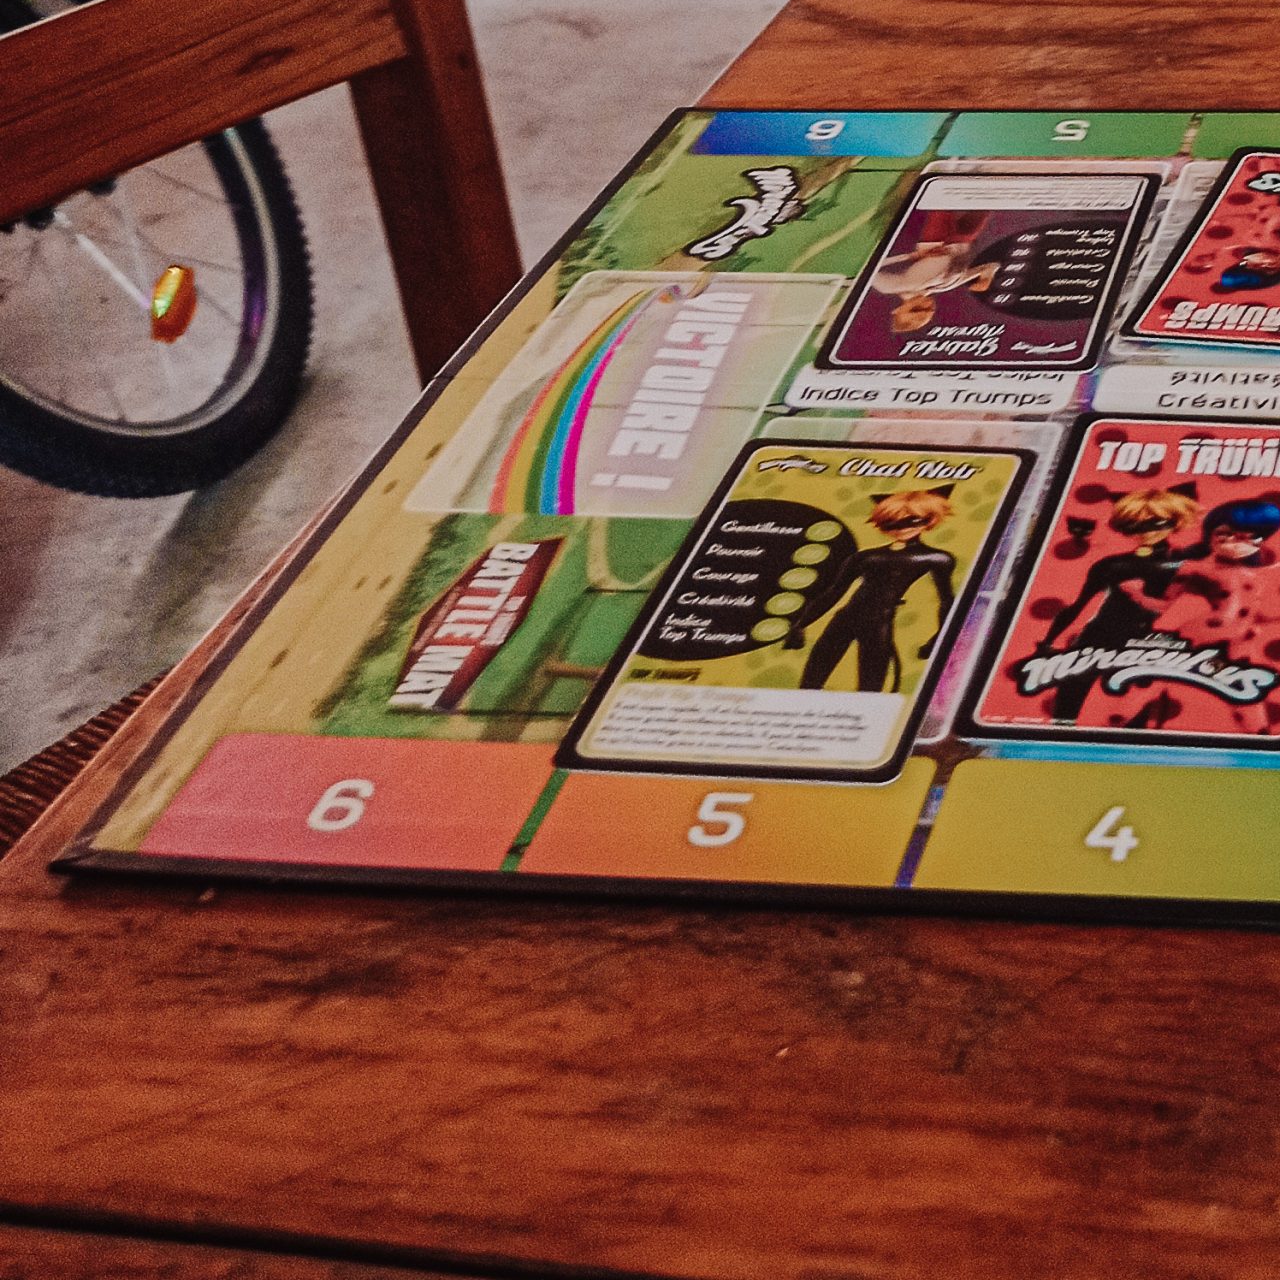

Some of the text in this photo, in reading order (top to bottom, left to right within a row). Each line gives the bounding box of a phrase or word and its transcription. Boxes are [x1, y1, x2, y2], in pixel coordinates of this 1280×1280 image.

[806, 119, 845, 141] 6
[1051, 120, 1090, 142] 5
[899, 337, 1001, 357] Gabriel
[607, 292, 754, 460] VICTOIRE
[799, 386, 1052, 406] Indice Top Trumps
[839, 457, 912, 478] Chat
[915, 459, 981, 480] Noir
[1096, 440, 1168, 473] TOP
[433, 542, 540, 640] BATTLE
[387, 644, 477, 710] MAT
[307, 778, 374, 832] 6
[687, 791, 754, 848] 5
[1084, 805, 1140, 862] 4
